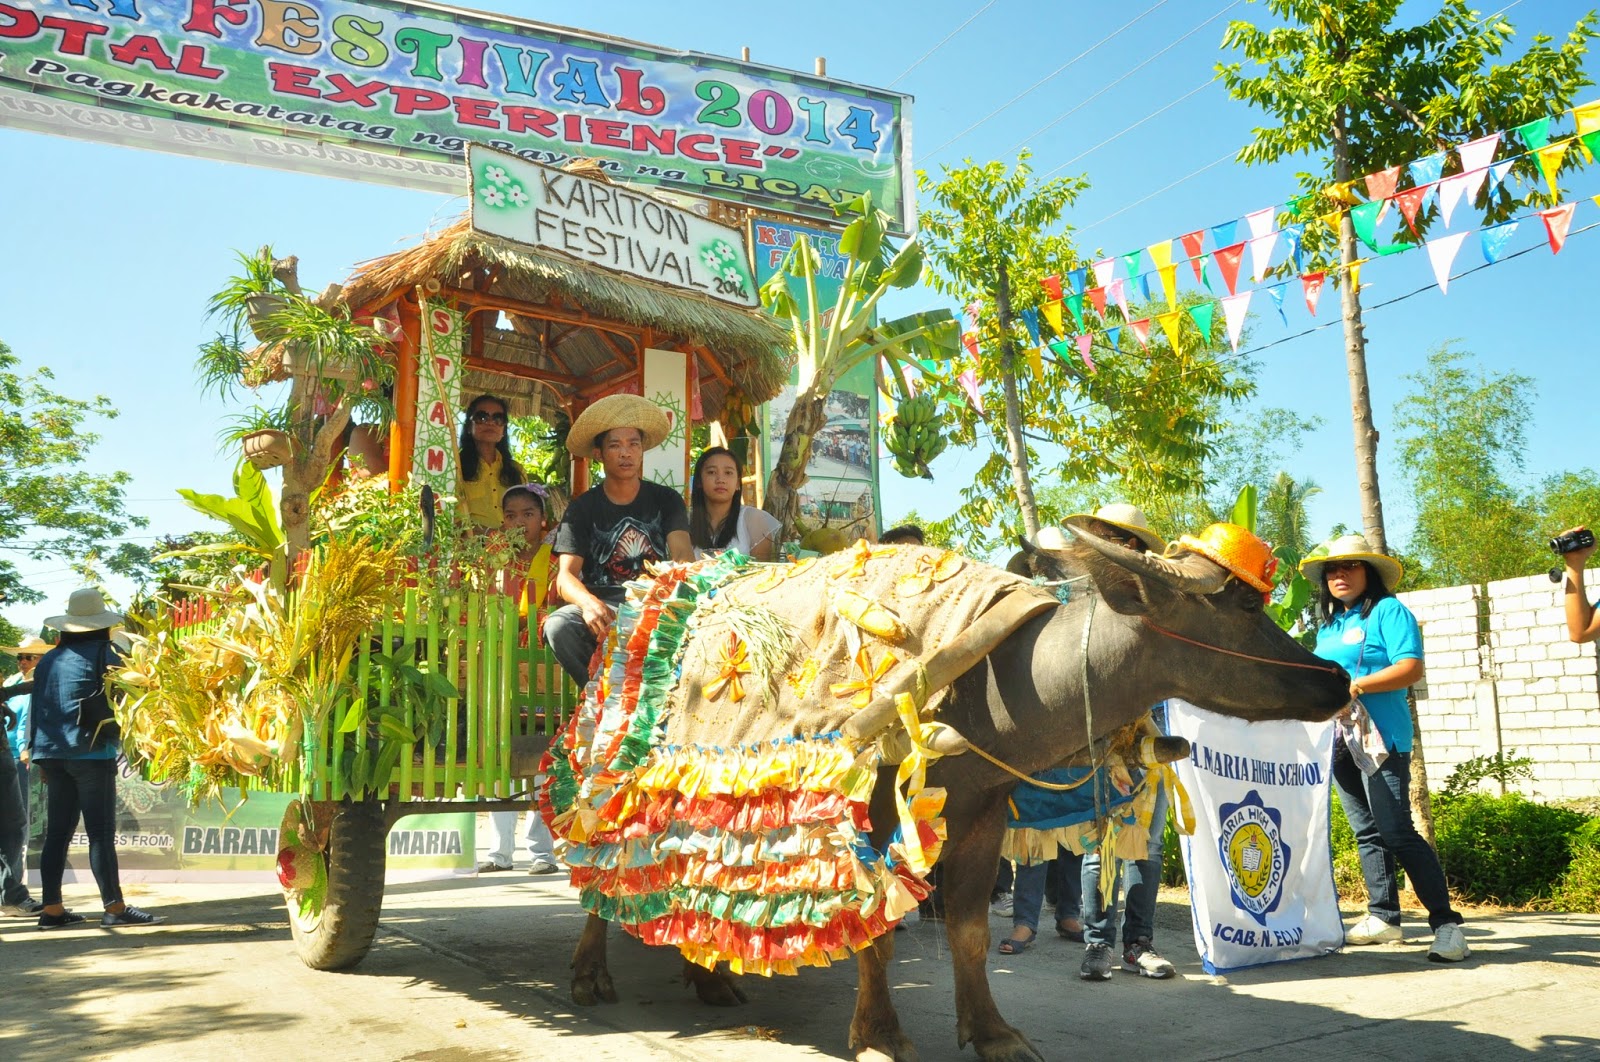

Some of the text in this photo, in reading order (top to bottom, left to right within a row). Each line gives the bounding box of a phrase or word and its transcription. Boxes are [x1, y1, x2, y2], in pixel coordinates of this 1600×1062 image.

[183, 0, 880, 152] FESTIVAL 2014
[28, 59, 396, 140] Pagkakatatag
[414, 130, 466, 152] ng
[636, 164, 687, 180] ng
[540, 168, 690, 245] KARITON
[535, 208, 709, 288] FESTIVAL
[713, 277, 749, 301] 2014
[1251, 758, 1276, 786] HIGH
[1279, 762, 1325, 787] SCHOOL
[131, 835, 173, 847] FROM:
[183, 827, 462, 855] BARAN MARIA
[1248, 808, 1269, 830] HIGH
[1269, 829, 1282, 889] SCHOOL
[1260, 929, 1273, 947] N.
